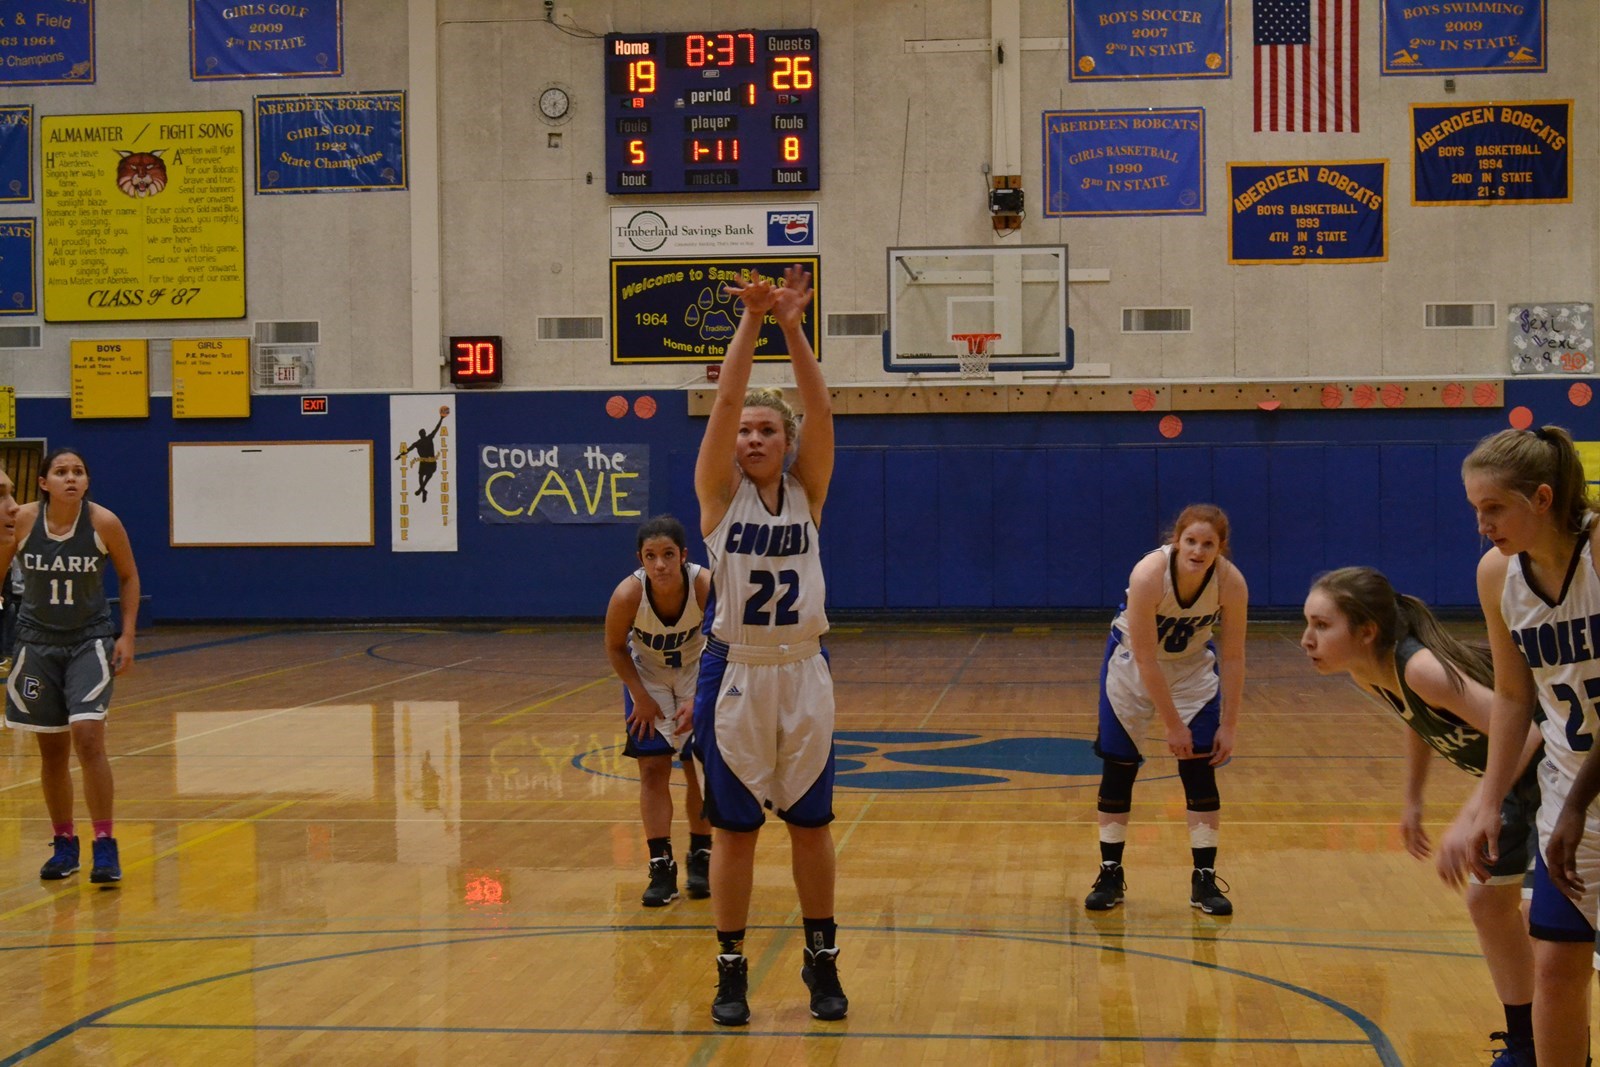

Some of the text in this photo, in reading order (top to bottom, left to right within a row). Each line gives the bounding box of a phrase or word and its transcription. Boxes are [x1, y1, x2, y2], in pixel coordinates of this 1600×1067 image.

[222, 4, 309, 19] GIRLS GOLF
[1098, 9, 1202, 26] BOYS SOCCER
[1402, 3, 1524, 20] BOYS SWIMMING
[15, 12, 26, 26] &
[36, 13, 72, 29] Field
[249, 23, 284, 33] 2009
[1445, 21, 1483, 32] 2009
[0, 36, 56, 46] 63 1964
[1131, 27, 1169, 39] 2007
[247, 40, 262, 51] IN
[264, 36, 307, 50] STATE
[614, 40, 650, 55] Home
[686, 33, 755, 66] 8:37
[768, 36, 811, 51] Guests
[1105, 41, 1196, 57] 2ND IN STATE
[1409, 35, 1521, 51] 2ND IN STATE
[7, 51, 65, 67] Champions
[629, 60, 656, 93] 19
[772, 57, 813, 89] 26
[691, 83, 756, 105] period 1
[260, 99, 401, 115] ABERDEEN BOBCATS
[619, 119, 648, 133] fouls
[691, 116, 731, 132] player
[774, 115, 804, 129] fouls
[1050, 118, 1199, 134] ABERDEEN BOBCATS
[1416, 107, 1566, 153] ABERDEEN BOBCATS
[49, 127, 123, 143] ALMA MATER
[160, 123, 234, 139] FIGHT SONG
[287, 124, 374, 141] GIRLS GOLF
[630, 140, 645, 164] 5
[783, 136, 799, 161] 8
[1068, 145, 1180, 166] GIRLS BASKETBALL
[1438, 145, 1541, 157] BOYS BASKETBALL
[280, 151, 383, 170] State Champions
[1108, 163, 1143, 174] 1990
[1478, 158, 1503, 169] 1994
[621, 172, 647, 186] bout
[692, 171, 731, 184] match
[777, 170, 803, 183] bout
[1105, 180, 1121, 192] IN
[1124, 175, 1170, 191] STATE
[1451, 172, 1533, 184] 2ND IN STATE
[1233, 167, 1382, 214] ABERDEEN BOBCATS
[1477, 187, 1489, 197] 21
[1257, 204, 1358, 215] BOYS BASKETBALL
[769, 213, 810, 225] PEPSI
[1296, 218, 1320, 228] 1993
[616, 223, 754, 238] Timberland Savings Bank
[1268, 231, 1347, 242] 4TH IN STATE
[1292, 245, 1306, 256] 23
[621, 271, 684, 300] Welcome
[689, 268, 703, 281] to
[708, 267, 737, 281] Sam
[87, 288, 144, 308] CLASS
[171, 287, 201, 306] '87
[635, 312, 668, 326] 1964
[197, 341, 223, 349] GIRLS
[663, 337, 724, 355] Home of the
[457, 343, 494, 375] 30
[1560, 351, 1588, 371] 10
[303, 399, 325, 410] EXIT
[584, 445, 627, 471] the
[399, 441, 409, 541] ATTITUDE
[484, 468, 642, 517] CAVE
[23, 553, 99, 573] CLARK
[49, 579, 74, 605] 11
[742, 568, 800, 626] 22
